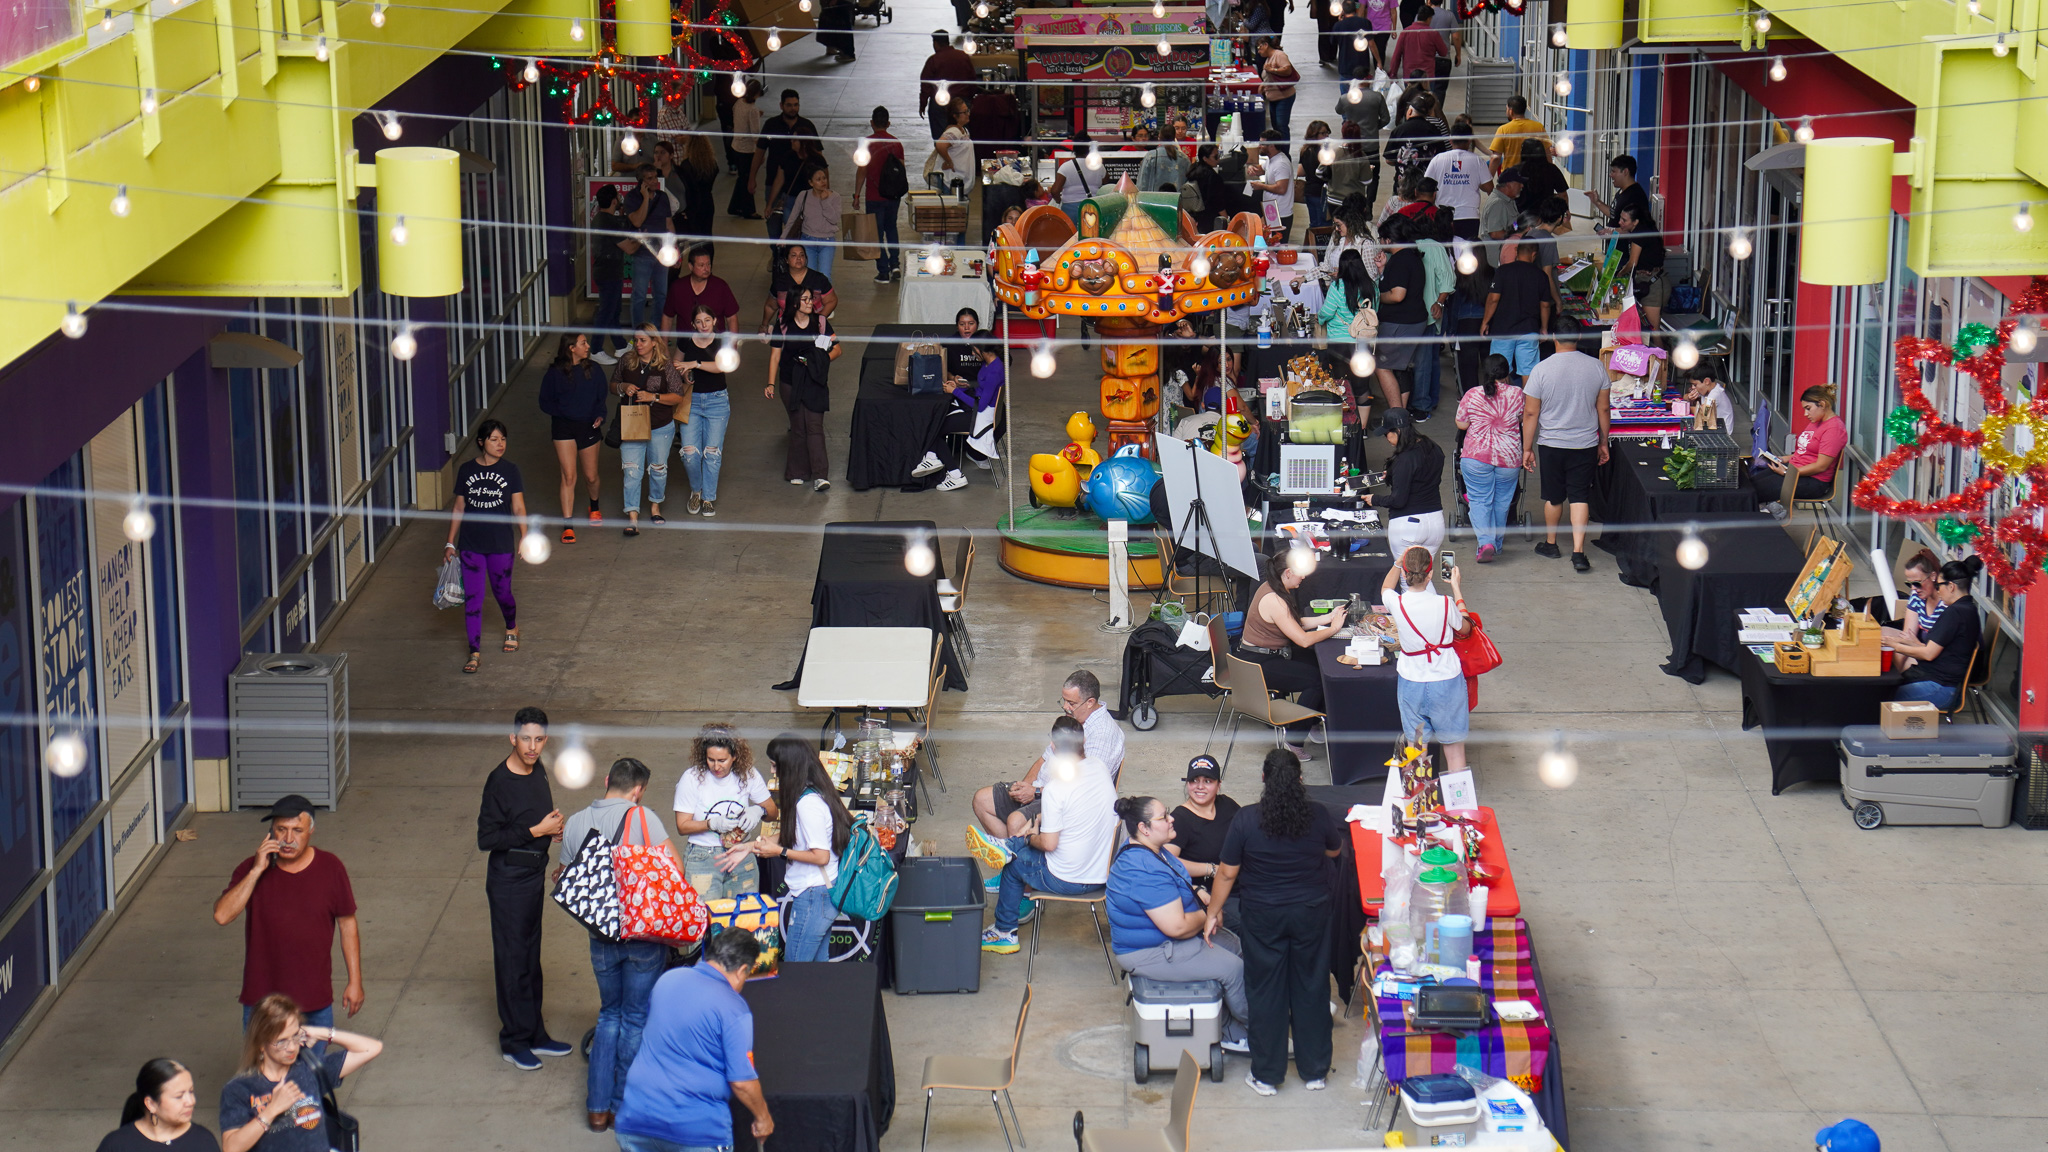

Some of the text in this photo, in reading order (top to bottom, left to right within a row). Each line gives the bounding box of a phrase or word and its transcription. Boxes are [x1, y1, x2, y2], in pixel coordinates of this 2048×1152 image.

[1154, 23, 1183, 32] FRESCAS
[465, 471, 508, 489] HOLLISTER
[468, 486, 503, 498] Surf Supply
[468, 497, 504, 509] CALIFORNIA
[100, 540, 134, 598] HANGRY
[41, 569, 83, 642] COOLEST
[108, 580, 130, 627] HELP
[43, 608, 87, 695] STORE
[105, 609, 138, 669] & CHEAP
